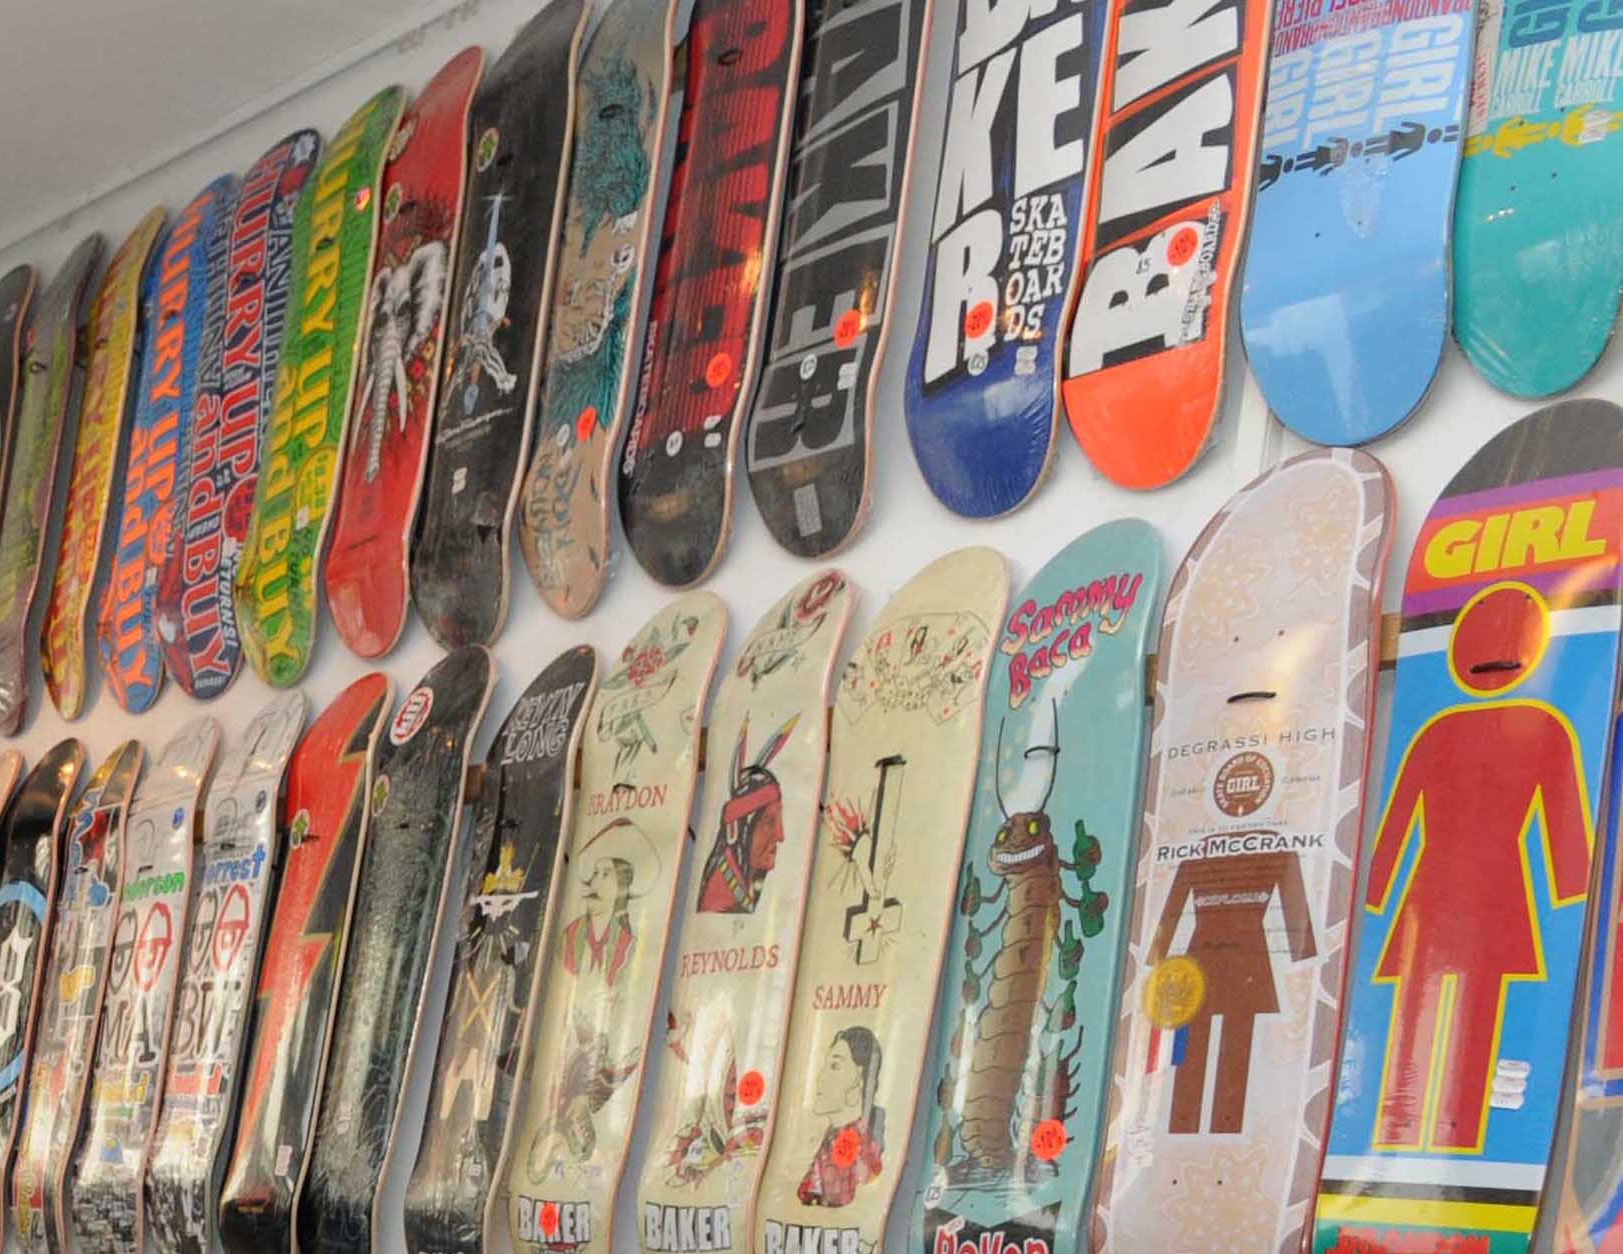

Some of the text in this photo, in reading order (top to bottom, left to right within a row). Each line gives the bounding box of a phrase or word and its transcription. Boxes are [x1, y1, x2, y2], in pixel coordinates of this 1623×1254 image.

[1304, 33, 1380, 149] GIRL
[1373, 14, 1465, 131] GIRL
[1008, 229, 1066, 270] TEB
[1009, 194, 1068, 233] SKA
[223, 146, 291, 369] HURRY
[1005, 266, 1064, 307] OAR
[1003, 303, 1045, 342] DS
[219, 376, 263, 477] UP
[290, 346, 333, 450] UP
[146, 410, 179, 501] UP
[187, 393, 224, 531] and
[1423, 499, 1607, 580] GIRL
[114, 556, 154, 688] BUY
[179, 531, 230, 675] BUY
[253, 514, 300, 661] BUY
[1000, 572, 1143, 657] Sammy
[1007, 622, 1093, 711] Baca
[500, 719, 570, 766] LONG
[1167, 727, 1338, 761] DEGRASSI HIGH
[1226, 775, 1261, 794] GIRL
[1156, 844, 1207, 863] RICK
[680, 942, 781, 980] REYNOLDS
[811, 982, 890, 1012] SAMMY
[644, 1201, 732, 1252] BAKER
